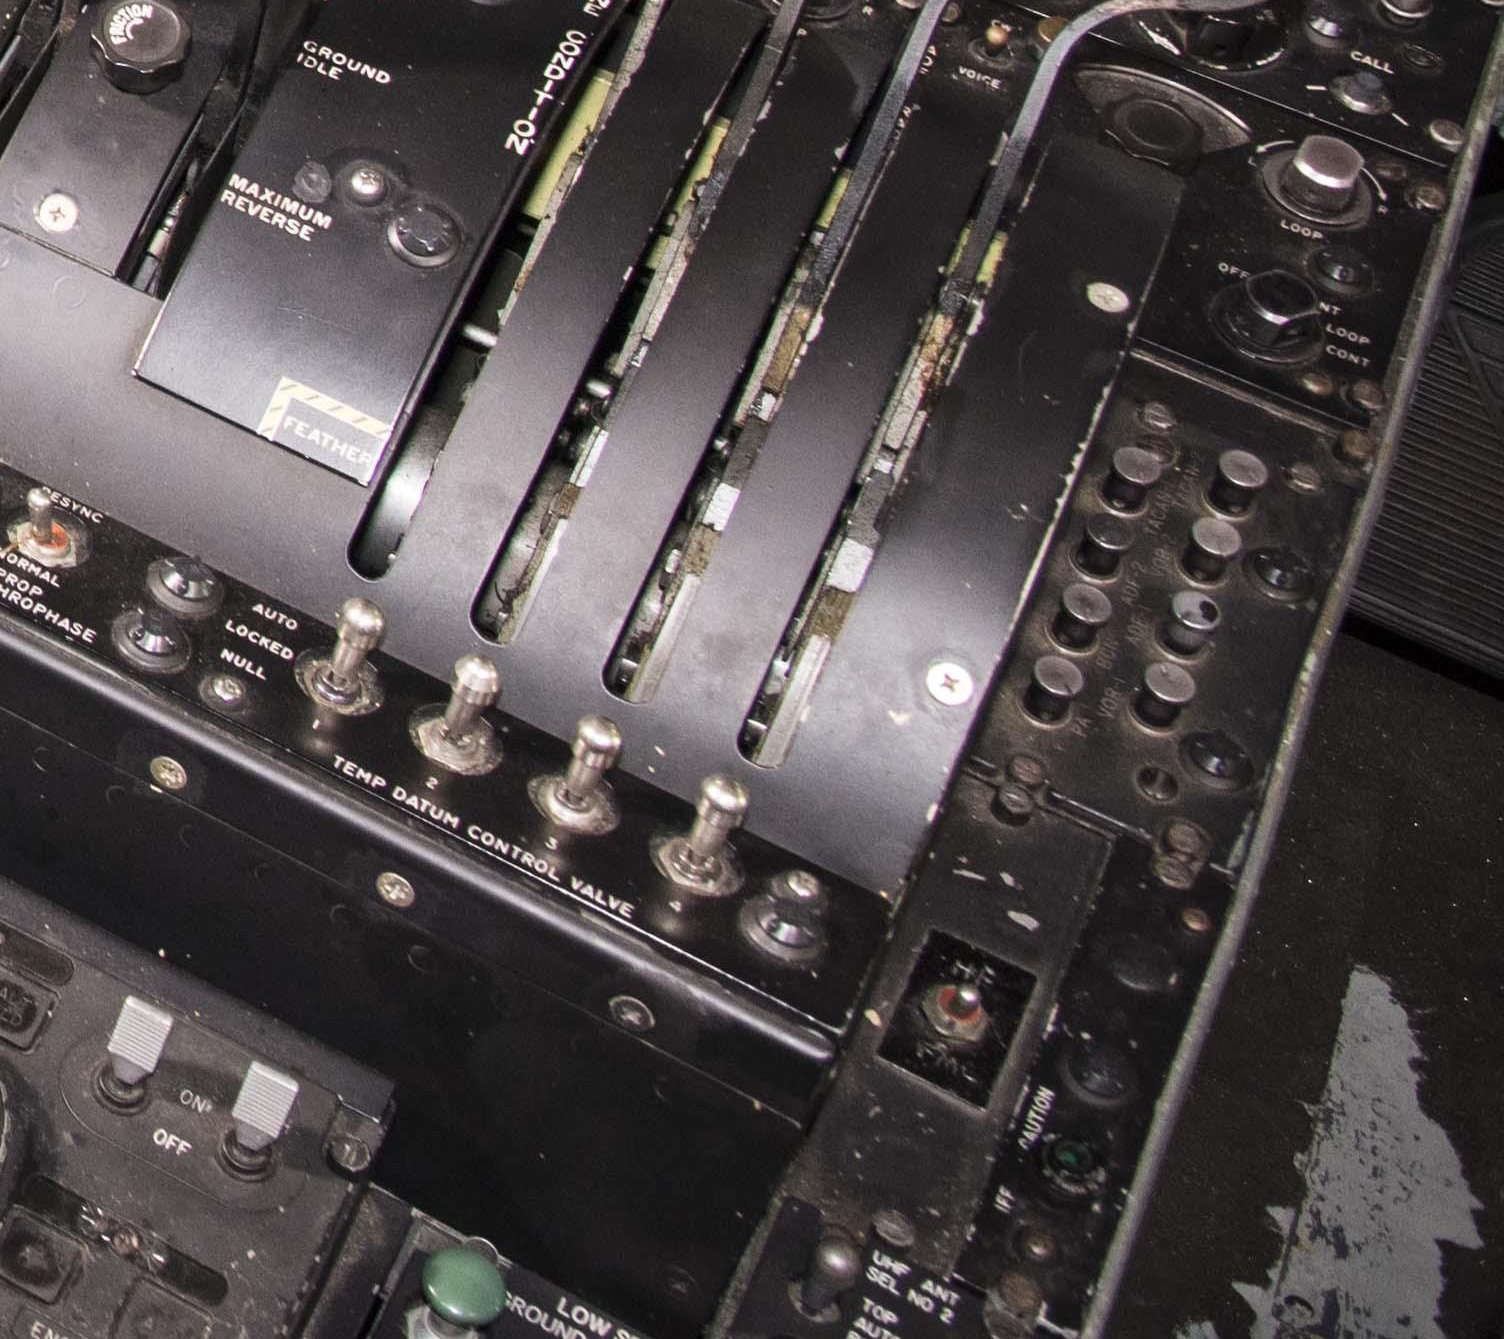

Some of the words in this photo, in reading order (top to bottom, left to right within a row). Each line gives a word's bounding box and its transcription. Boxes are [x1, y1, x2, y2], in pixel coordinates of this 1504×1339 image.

[110, 4, 154, 45] FRICTION
[297, 54, 341, 81] IDLE
[302, 40, 391, 84] GROUND
[1351, 50, 1393, 75] CALL
[220, 191, 314, 242] REVERSE
[229, 173, 332, 228] MAXIMUM
[1280, 220, 1324, 241] LOOP
[1326, 323, 1370, 347] LOOP
[1326, 345, 1370, 367] CONT
[283, 415, 373, 468] FEATHER
[252, 603, 299, 631] AUTO
[225, 619, 295, 662] LOCKED
[220, 649, 267, 681] NULL
[332, 755, 388, 795] TEMP
[392, 786, 461, 830] DATUM
[466, 822, 561, 892] CONTROL
[569, 874, 635, 920] VALVE
[1019, 1086, 1055, 1150] CAUTION
[152, 1128, 191, 1157] OFF
